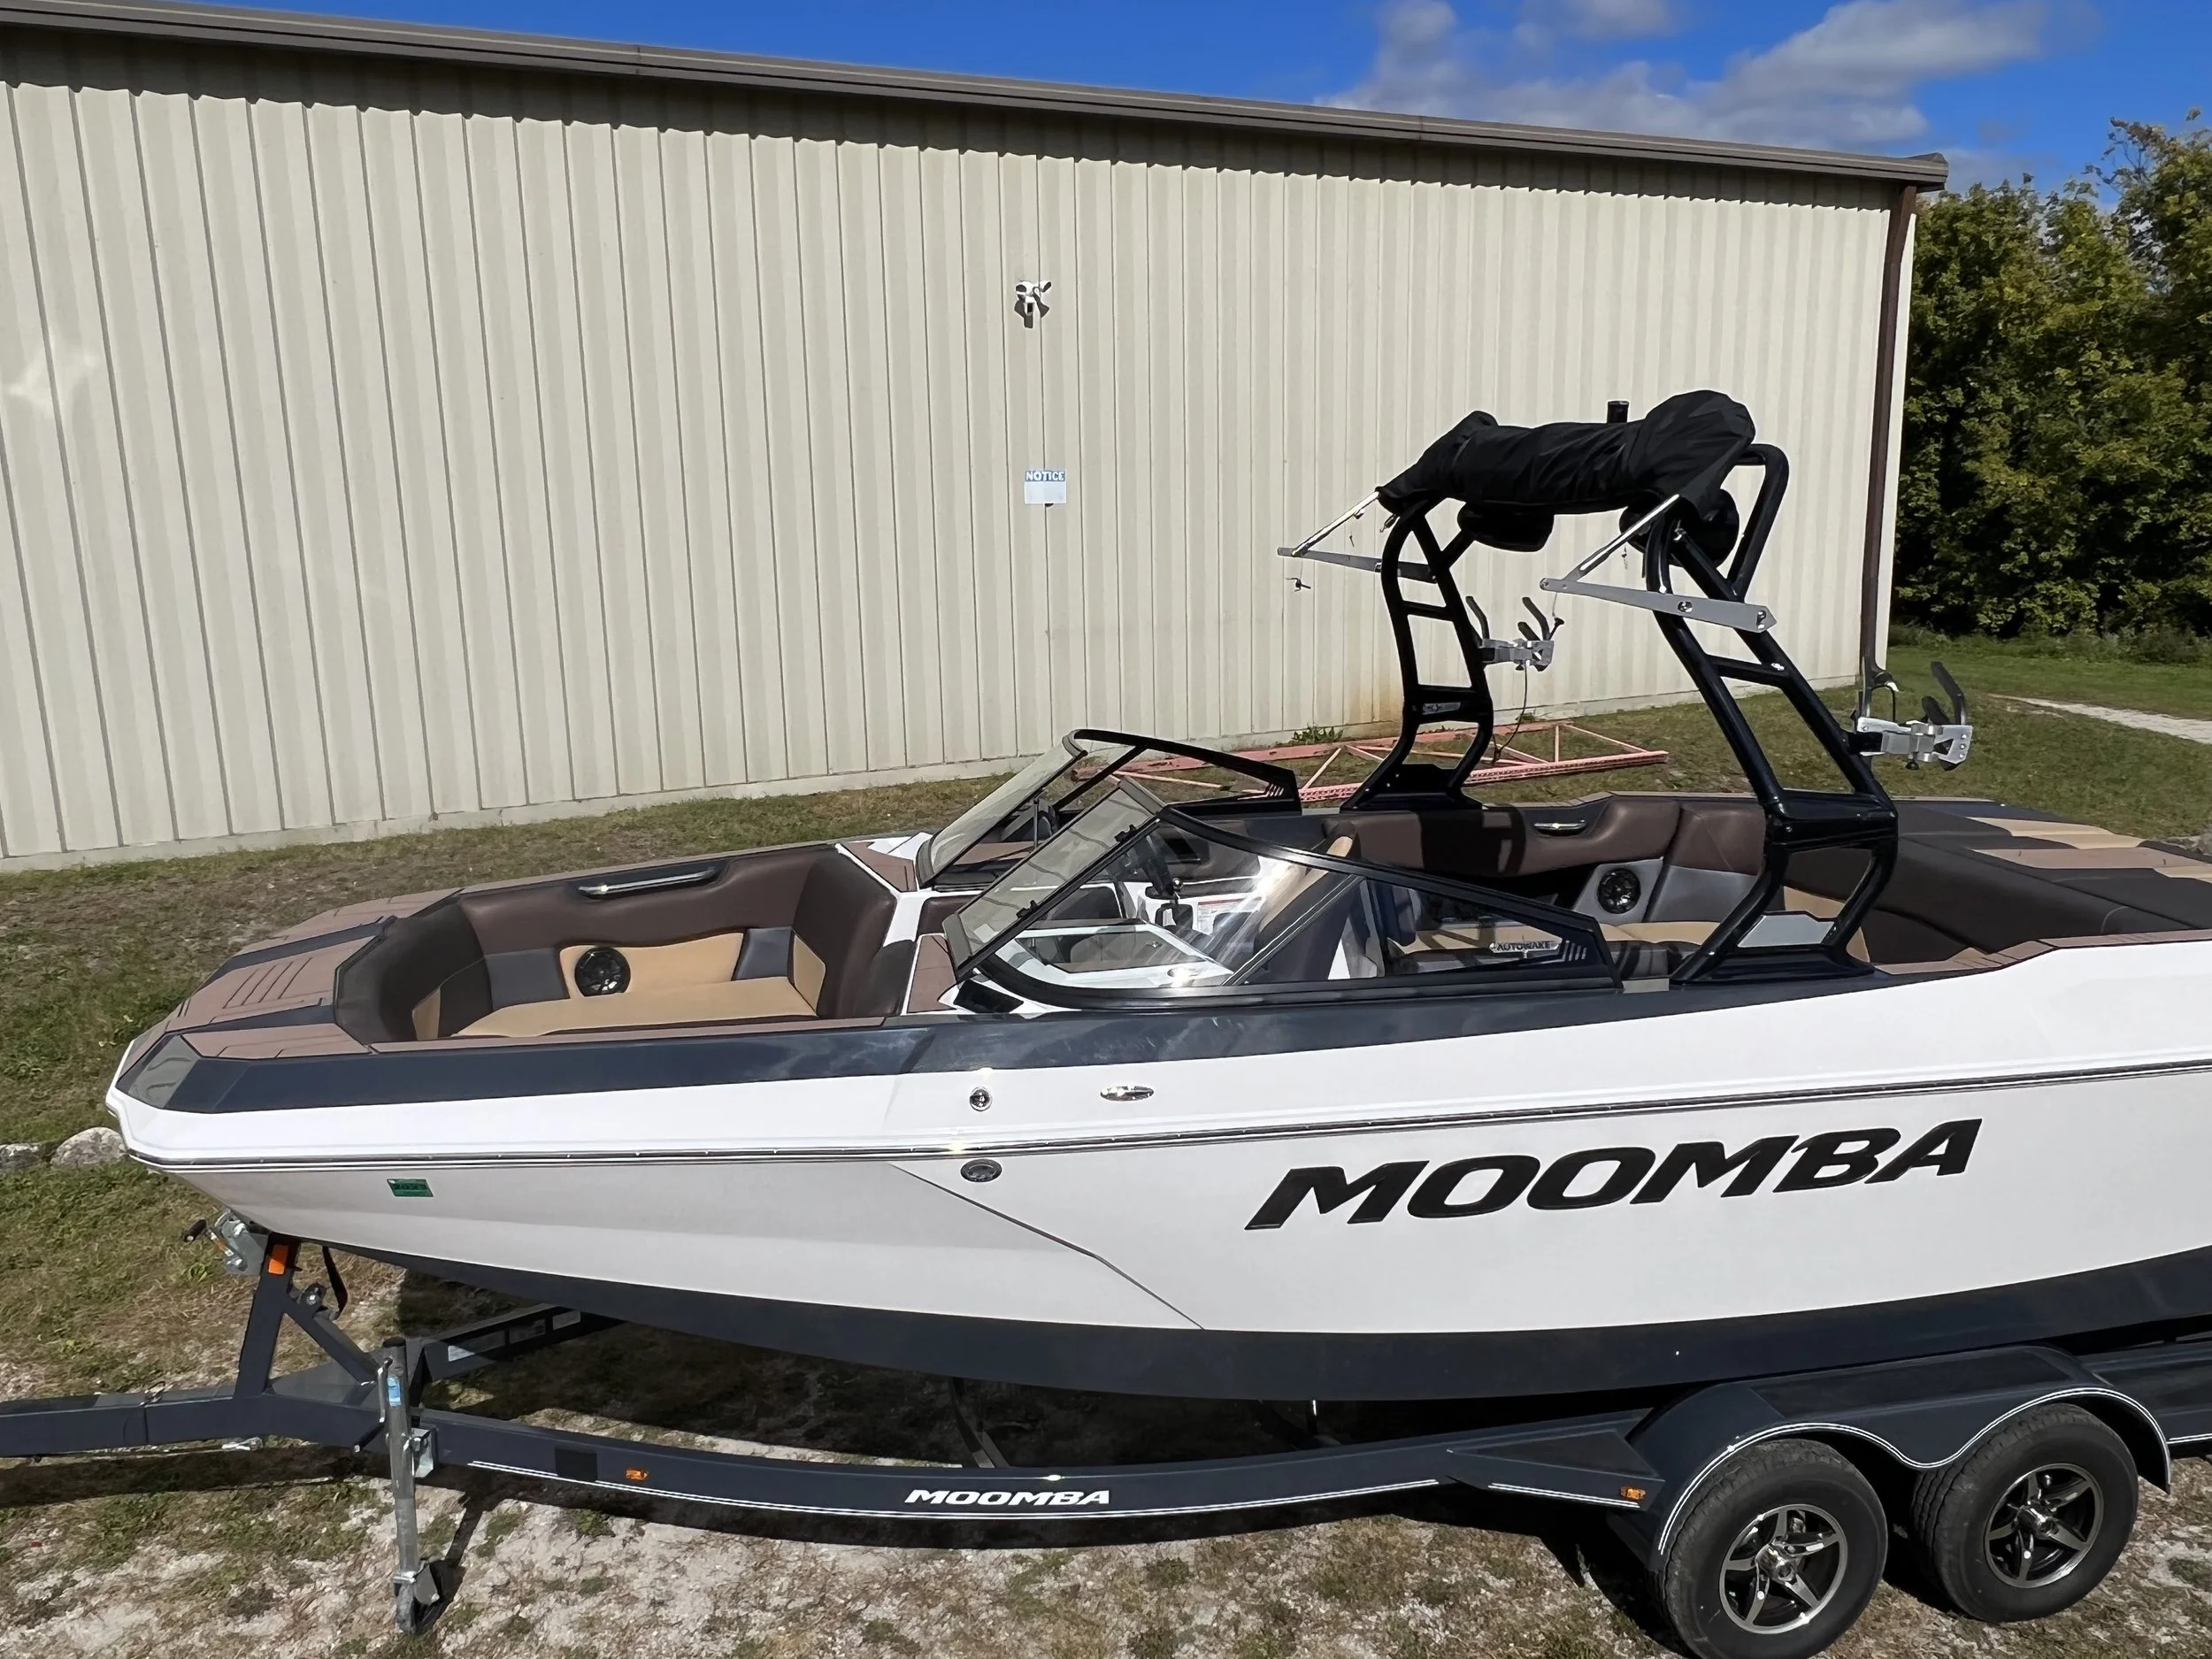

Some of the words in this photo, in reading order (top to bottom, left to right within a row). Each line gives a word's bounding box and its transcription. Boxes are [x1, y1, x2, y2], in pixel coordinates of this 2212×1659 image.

[1025, 471, 1065, 481] NOTICE
[1244, 1118, 1983, 1231] MOOMBA
[904, 1489, 1110, 1506] MOOMBA
